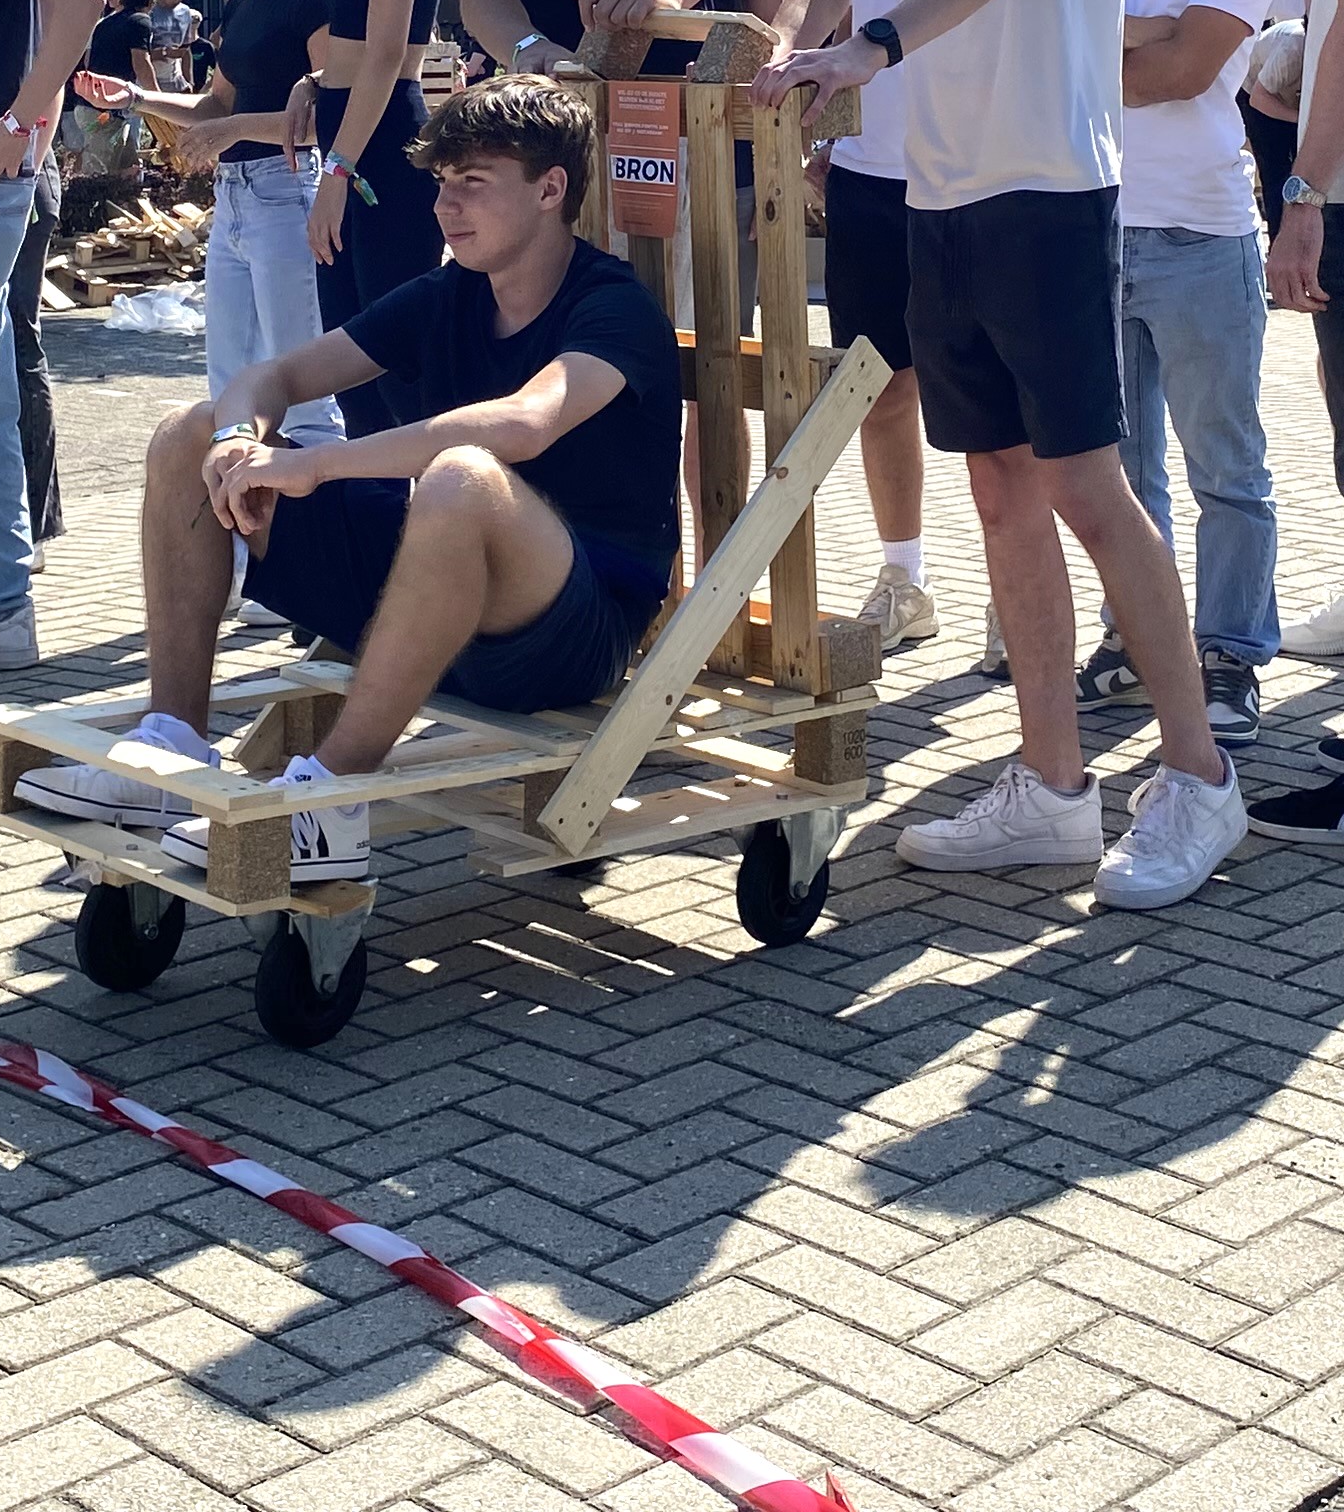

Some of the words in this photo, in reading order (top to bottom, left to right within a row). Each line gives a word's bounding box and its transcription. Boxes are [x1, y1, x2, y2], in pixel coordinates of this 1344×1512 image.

[615, 156, 675, 185] BRON
[843, 728, 866, 745] 1020
[844, 744, 863, 761] 600
